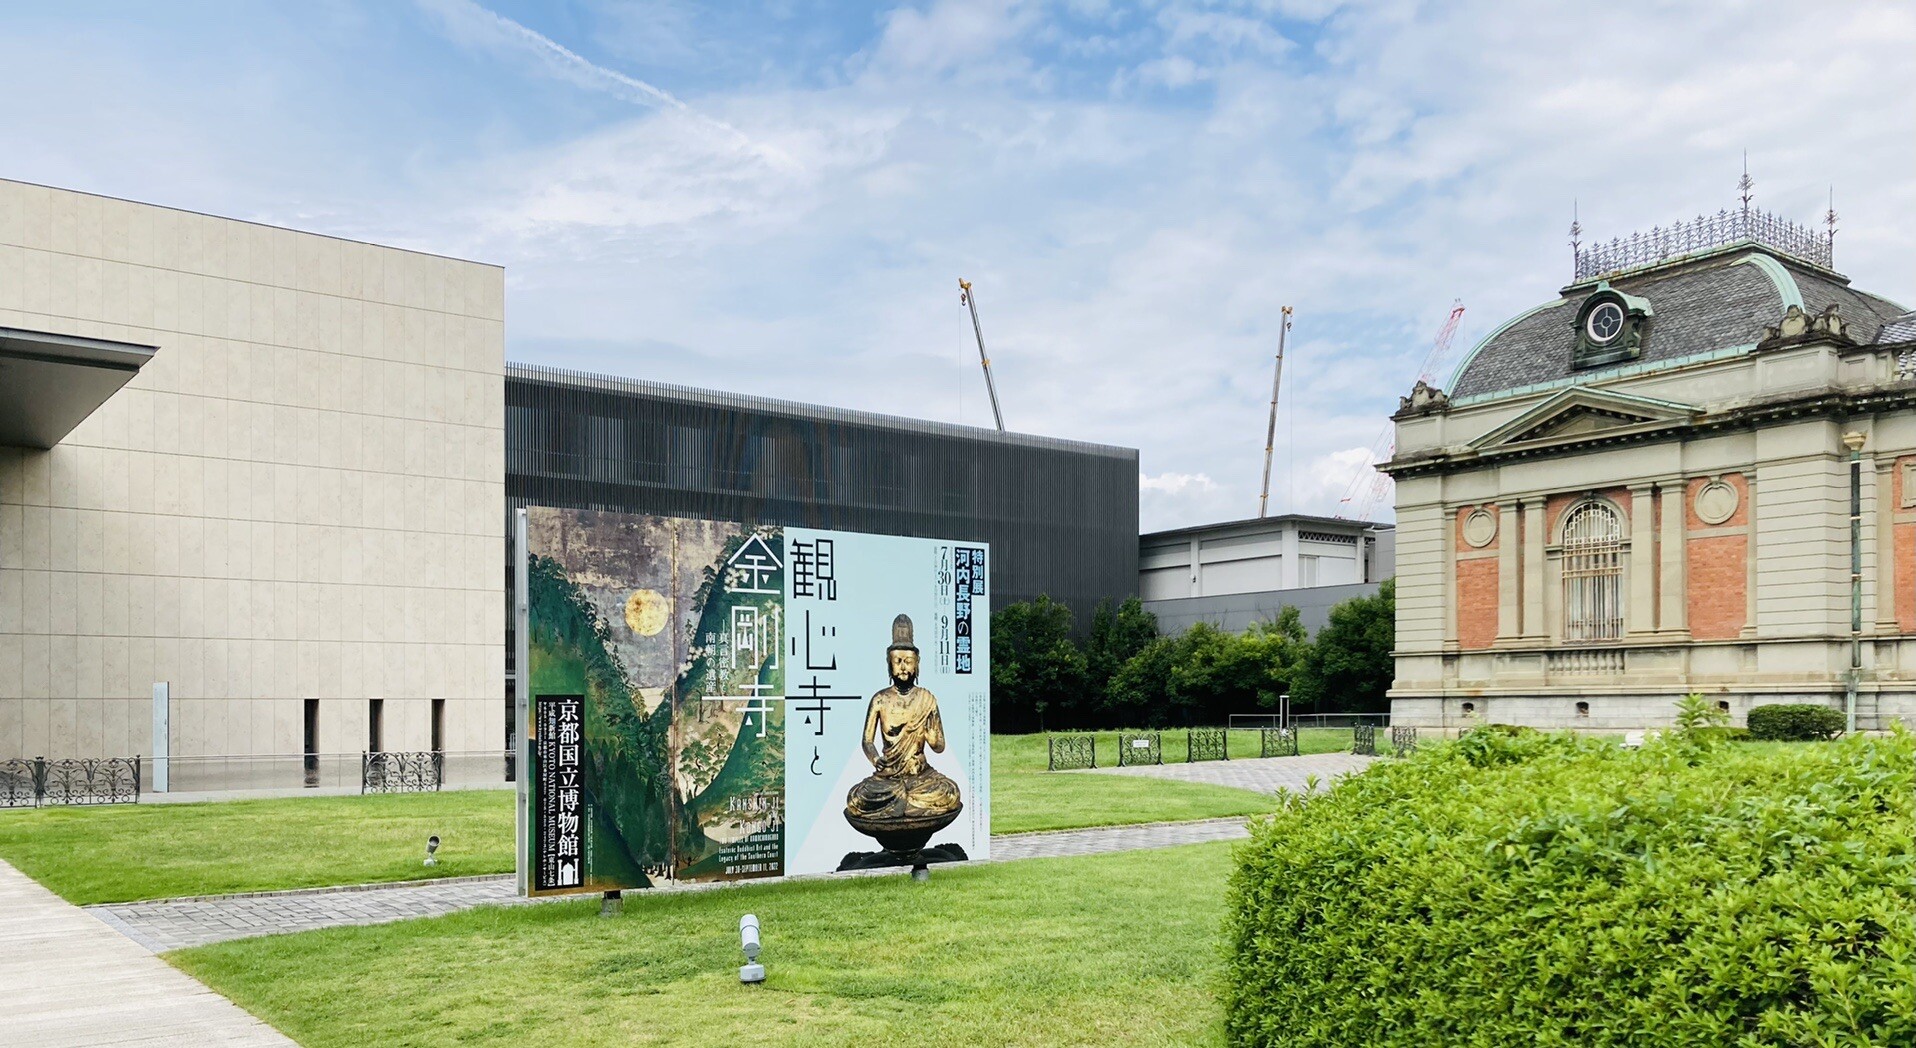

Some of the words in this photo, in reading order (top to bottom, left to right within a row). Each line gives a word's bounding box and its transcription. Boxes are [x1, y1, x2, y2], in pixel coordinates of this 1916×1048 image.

[972, 549, 983, 594] 特別展
[956, 549, 970, 671] 河内長野の霊地
[702, 533, 784, 737] 金剛寺
[790, 537, 862, 776] 観心寺と
[704, 631, 717, 693] 南朝の遺産
[548, 741, 556, 770] KYOTO
[557, 698, 580, 857] 京都国立博物館
[548, 771, 556, 814] NATIONAL
[548, 815, 556, 851] MUSEUM
[737, 844, 756, 853] Buddhist
[763, 842, 771, 851] and
[771, 842, 779, 850] the
[718, 854, 734, 863] Legacy
[740, 853, 748, 861] the
[748, 852, 767, 860] Southern
